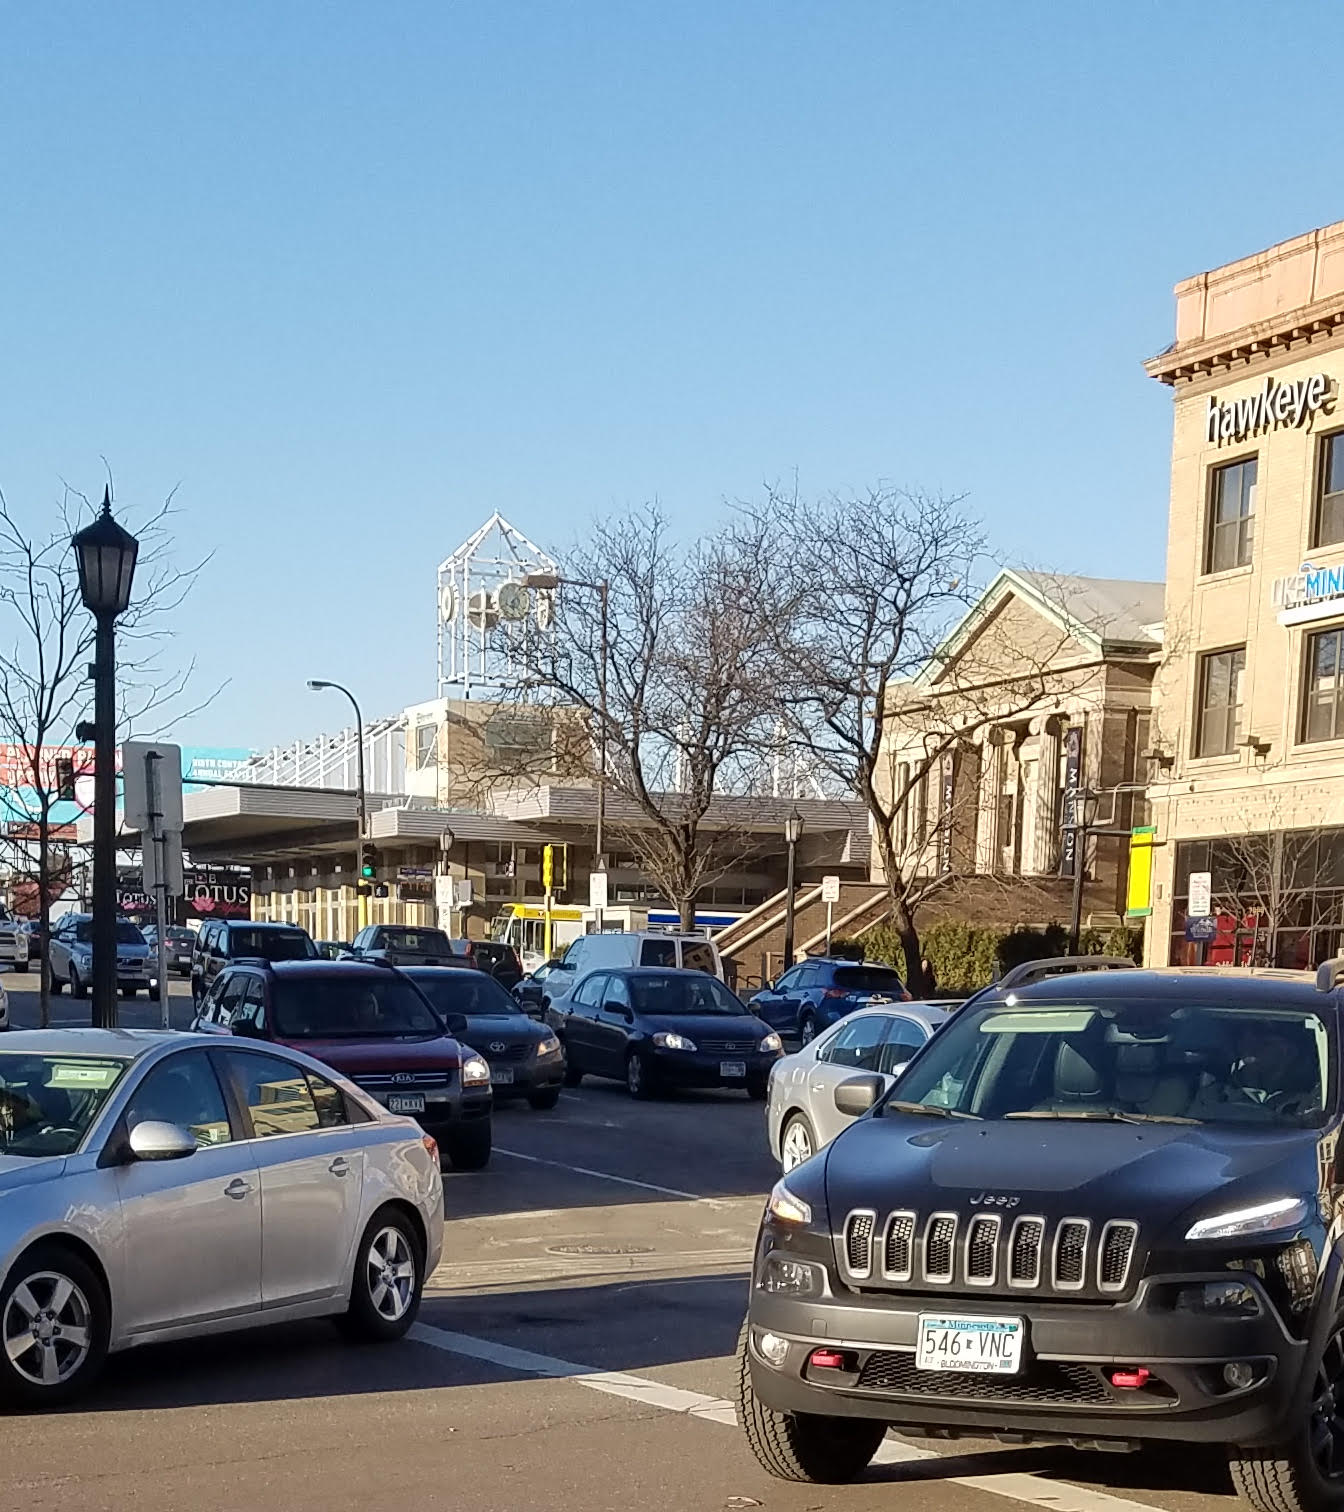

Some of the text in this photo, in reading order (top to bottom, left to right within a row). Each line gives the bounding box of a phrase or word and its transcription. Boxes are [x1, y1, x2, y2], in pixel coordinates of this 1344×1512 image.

[1205, 373, 1326, 443] hawkeye
[184, 884, 249, 904] LOTUS
[969, 1191, 1021, 1208] Jeep
[948, 1319, 995, 1330] Minnesota
[925, 1330, 1015, 1357] 546 VNC
[941, 1360, 994, 1370] BLOOMINGTON
